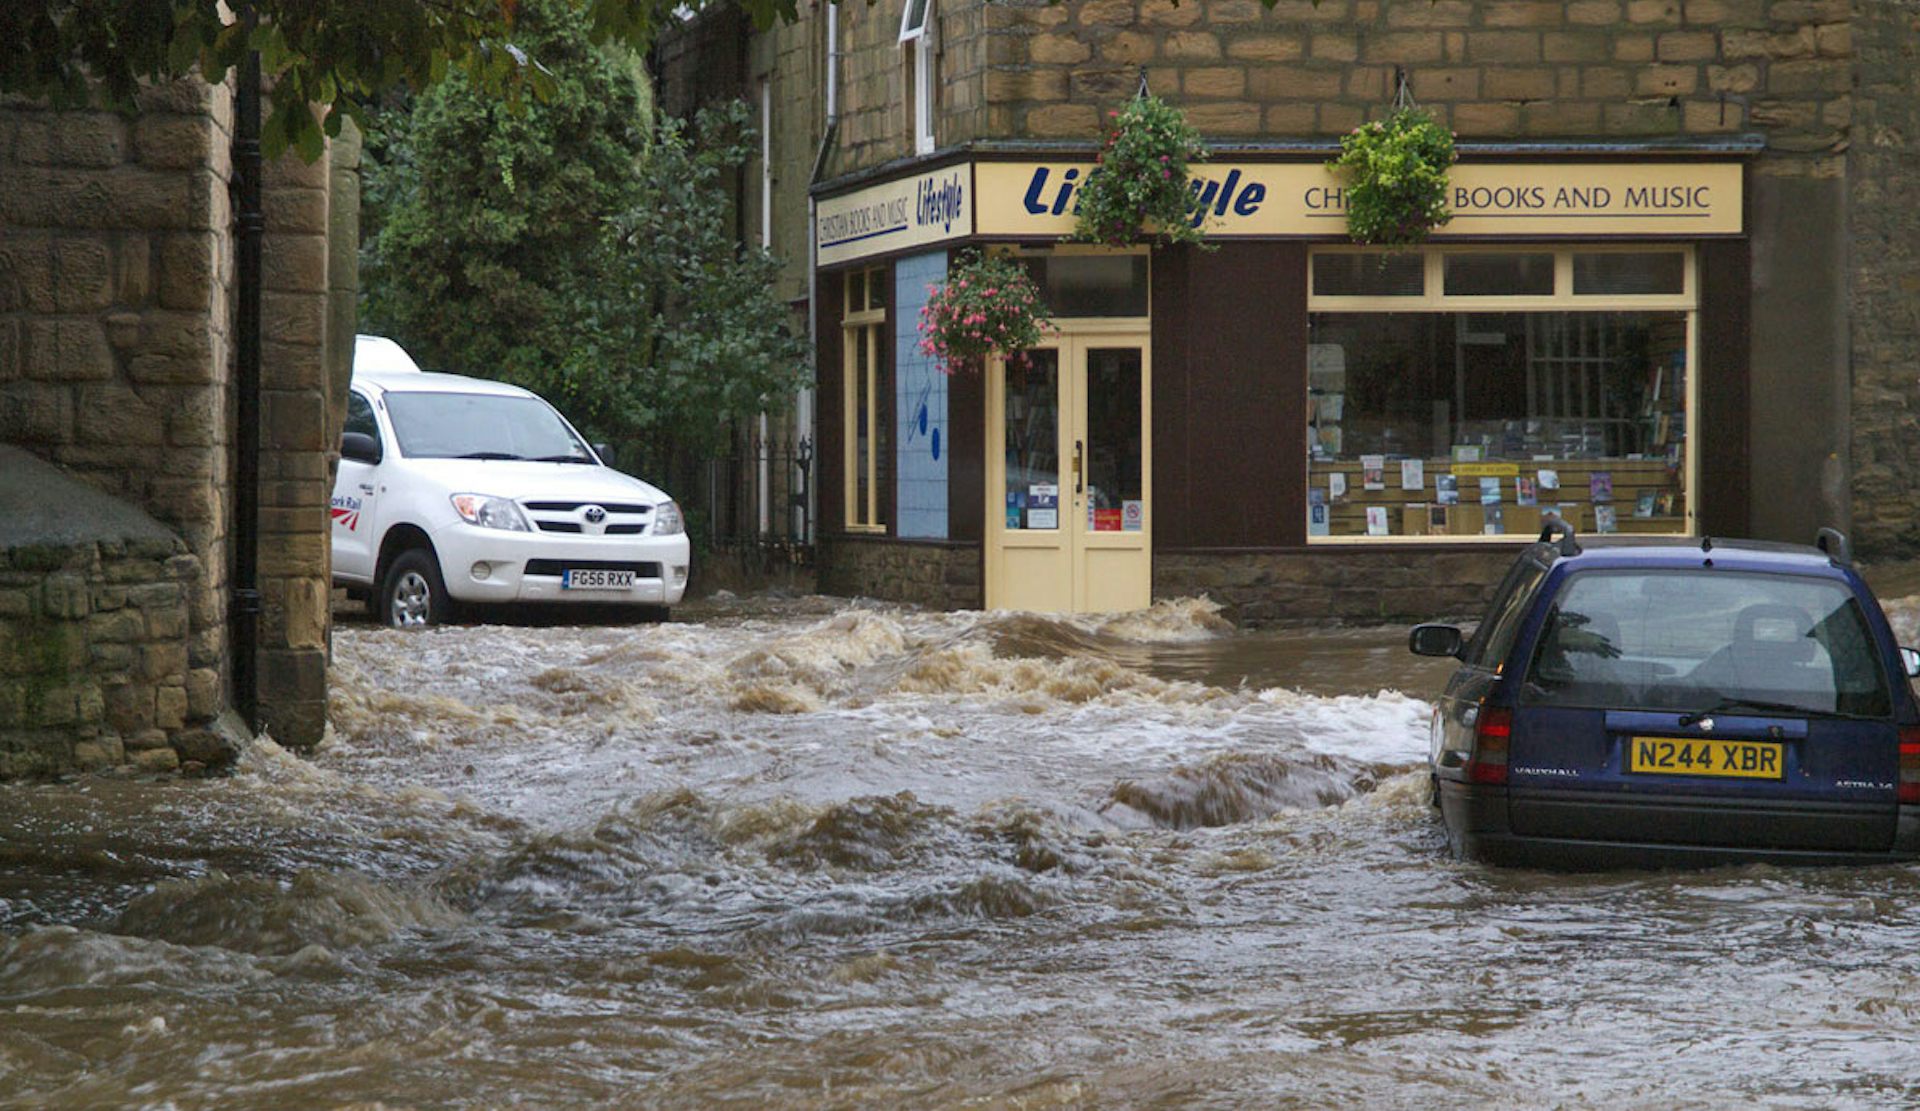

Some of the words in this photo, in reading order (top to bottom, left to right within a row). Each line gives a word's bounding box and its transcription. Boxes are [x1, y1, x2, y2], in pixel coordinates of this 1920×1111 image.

[917, 173, 962, 233] Lifestyle
[1023, 167, 1267, 228] Liyle
[1455, 187, 1545, 208] BOOKS
[1553, 187, 1611, 208] AND
[1624, 186, 1710, 208] MUSIC
[850, 206, 871, 235] BOOKS
[872, 201, 887, 229] AND
[346, 497, 362, 510] Rail
[572, 571, 605, 585] FG56
[607, 572, 633, 586] RXX
[1639, 742, 1713, 768] N244
[1722, 745, 1777, 771] XBR
[1514, 766, 1580, 777] VAUXHALL
